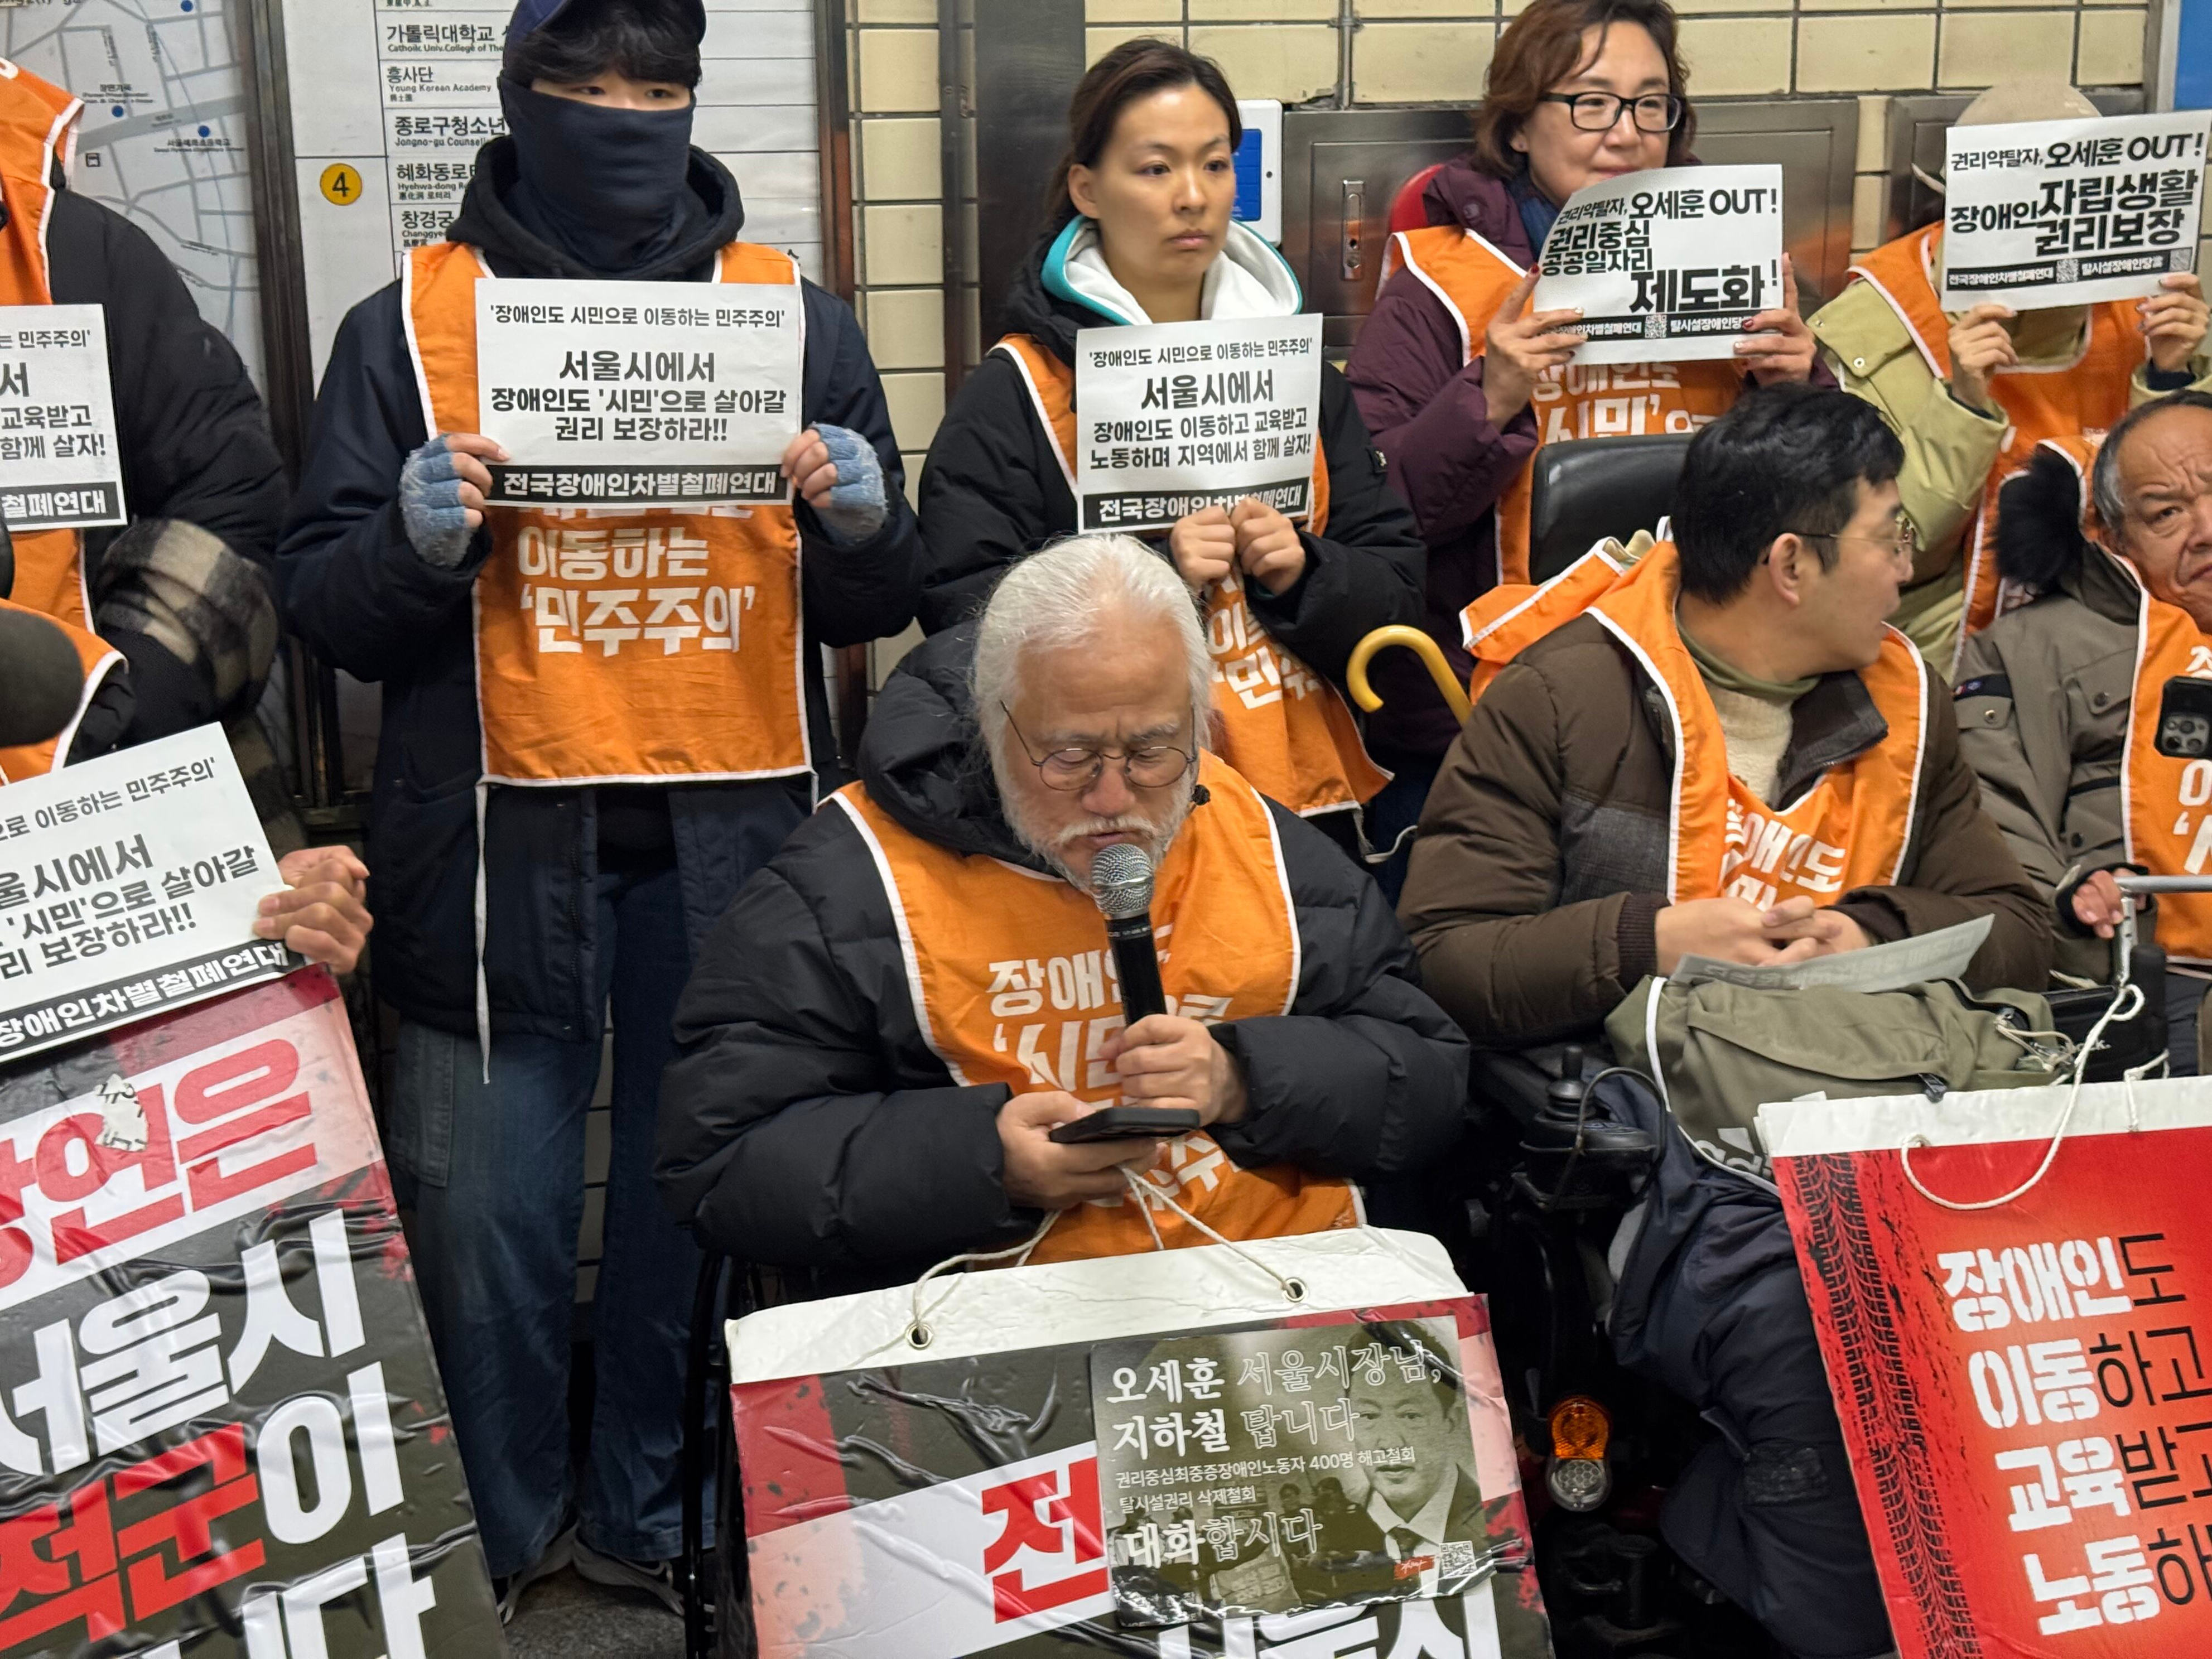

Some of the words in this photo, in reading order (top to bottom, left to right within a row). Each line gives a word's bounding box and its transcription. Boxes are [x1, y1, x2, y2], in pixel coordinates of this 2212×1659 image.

[387, 24, 495, 43] 가톨릭대학교
[387, 66, 433, 84] 흥사단
[389, 84, 417, 93] Young
[452, 84, 491, 92] Academy
[395, 116, 505, 137] 종로구청소년
[395, 138, 445, 147] Jongno-gu
[1951, 147, 2044, 171] 권리약탈자,
[2045, 138, 2123, 168] 오세훈
[332, 172, 350, 197] 4
[398, 183, 456, 192] Hyehwa-dong
[2038, 168, 2199, 216] 자립생활
[1629, 189, 1704, 219] 오세훈
[1950, 201, 2038, 233] 장애인
[1549, 220, 1650, 253] 권리중심
[2035, 209, 2185, 257] 권리보장
[1542, 248, 1653, 276] 공공일자리
[1629, 259, 1777, 313] 제도화!
[490, 305, 564, 325] '장애인도
[570, 306, 638, 325] 시민으로
[644, 307, 710, 327] 이동하는
[716, 308, 785, 328] 민주주의'
[1670, 316, 1752, 333] 탈시설장애인당
[18, 329, 90, 349] 민주주의'
[1090, 349, 1153, 368] '장애인도
[1158, 345, 1212, 364] 시민으로
[1217, 341, 1264, 360] 이동하는
[1268, 337, 1313, 356] 민주주의'
[559, 350, 715, 383] 서울시에서
[491, 387, 591, 413] 장애인도
[599, 388, 707, 414] '시민'으로
[714, 389, 787, 414] 살아갈
[1141, 369, 1274, 411] 서울시에서
[1, 405, 93, 430] 교육받고
[555, 417, 604, 441] 권리
[613, 417, 727, 442] 보장하라!!
[1093, 418, 1173, 443] 장애인도
[1180, 412, 1249, 438] 이동하고
[1255, 407, 1307, 433] 교육받고
[0, 435, 46, 460] 함께
[53, 433, 107, 458] 살자!
[1090, 445, 1170, 470] 노동하며
[1178, 440, 1248, 466] 지역에서
[1253, 437, 1279, 461] 함께
[1284, 433, 1312, 457] 살자!
[503, 471, 777, 498] 전국장애인차별철폐연대
[517, 525, 709, 581] 이동하는
[35, 789, 123, 830] 이동하는
[126, 756, 215, 802] 민주주의'
[7, 880, 157, 941] '시민'으로
[161, 845, 260, 900] 살아갈
[42, 902, 197, 969] 보장하라!!
[1938, 1233, 2186, 1332] 장애인도
[1106, 1357, 1226, 1405] 오세훈
[1236, 1339, 1442, 1397] 서울시장님,
[1967, 1326, 2212, 1430] 이동하고
[1112, 1409, 1230, 1460] 지하철
[1240, 1398, 1360, 1450] 탑니다
[1116, 1456, 1306, 1489] 권리중심최중증장애인노동자
[1309, 1453, 1354, 1471] 400명
[1357, 1446, 1416, 1467] 해고철회
[1119, 1491, 1193, 1514] 탈시설권리
[1197, 1485, 1257, 1506] 삭제철회
[1124, 1508, 1324, 1569] 대화합시다
